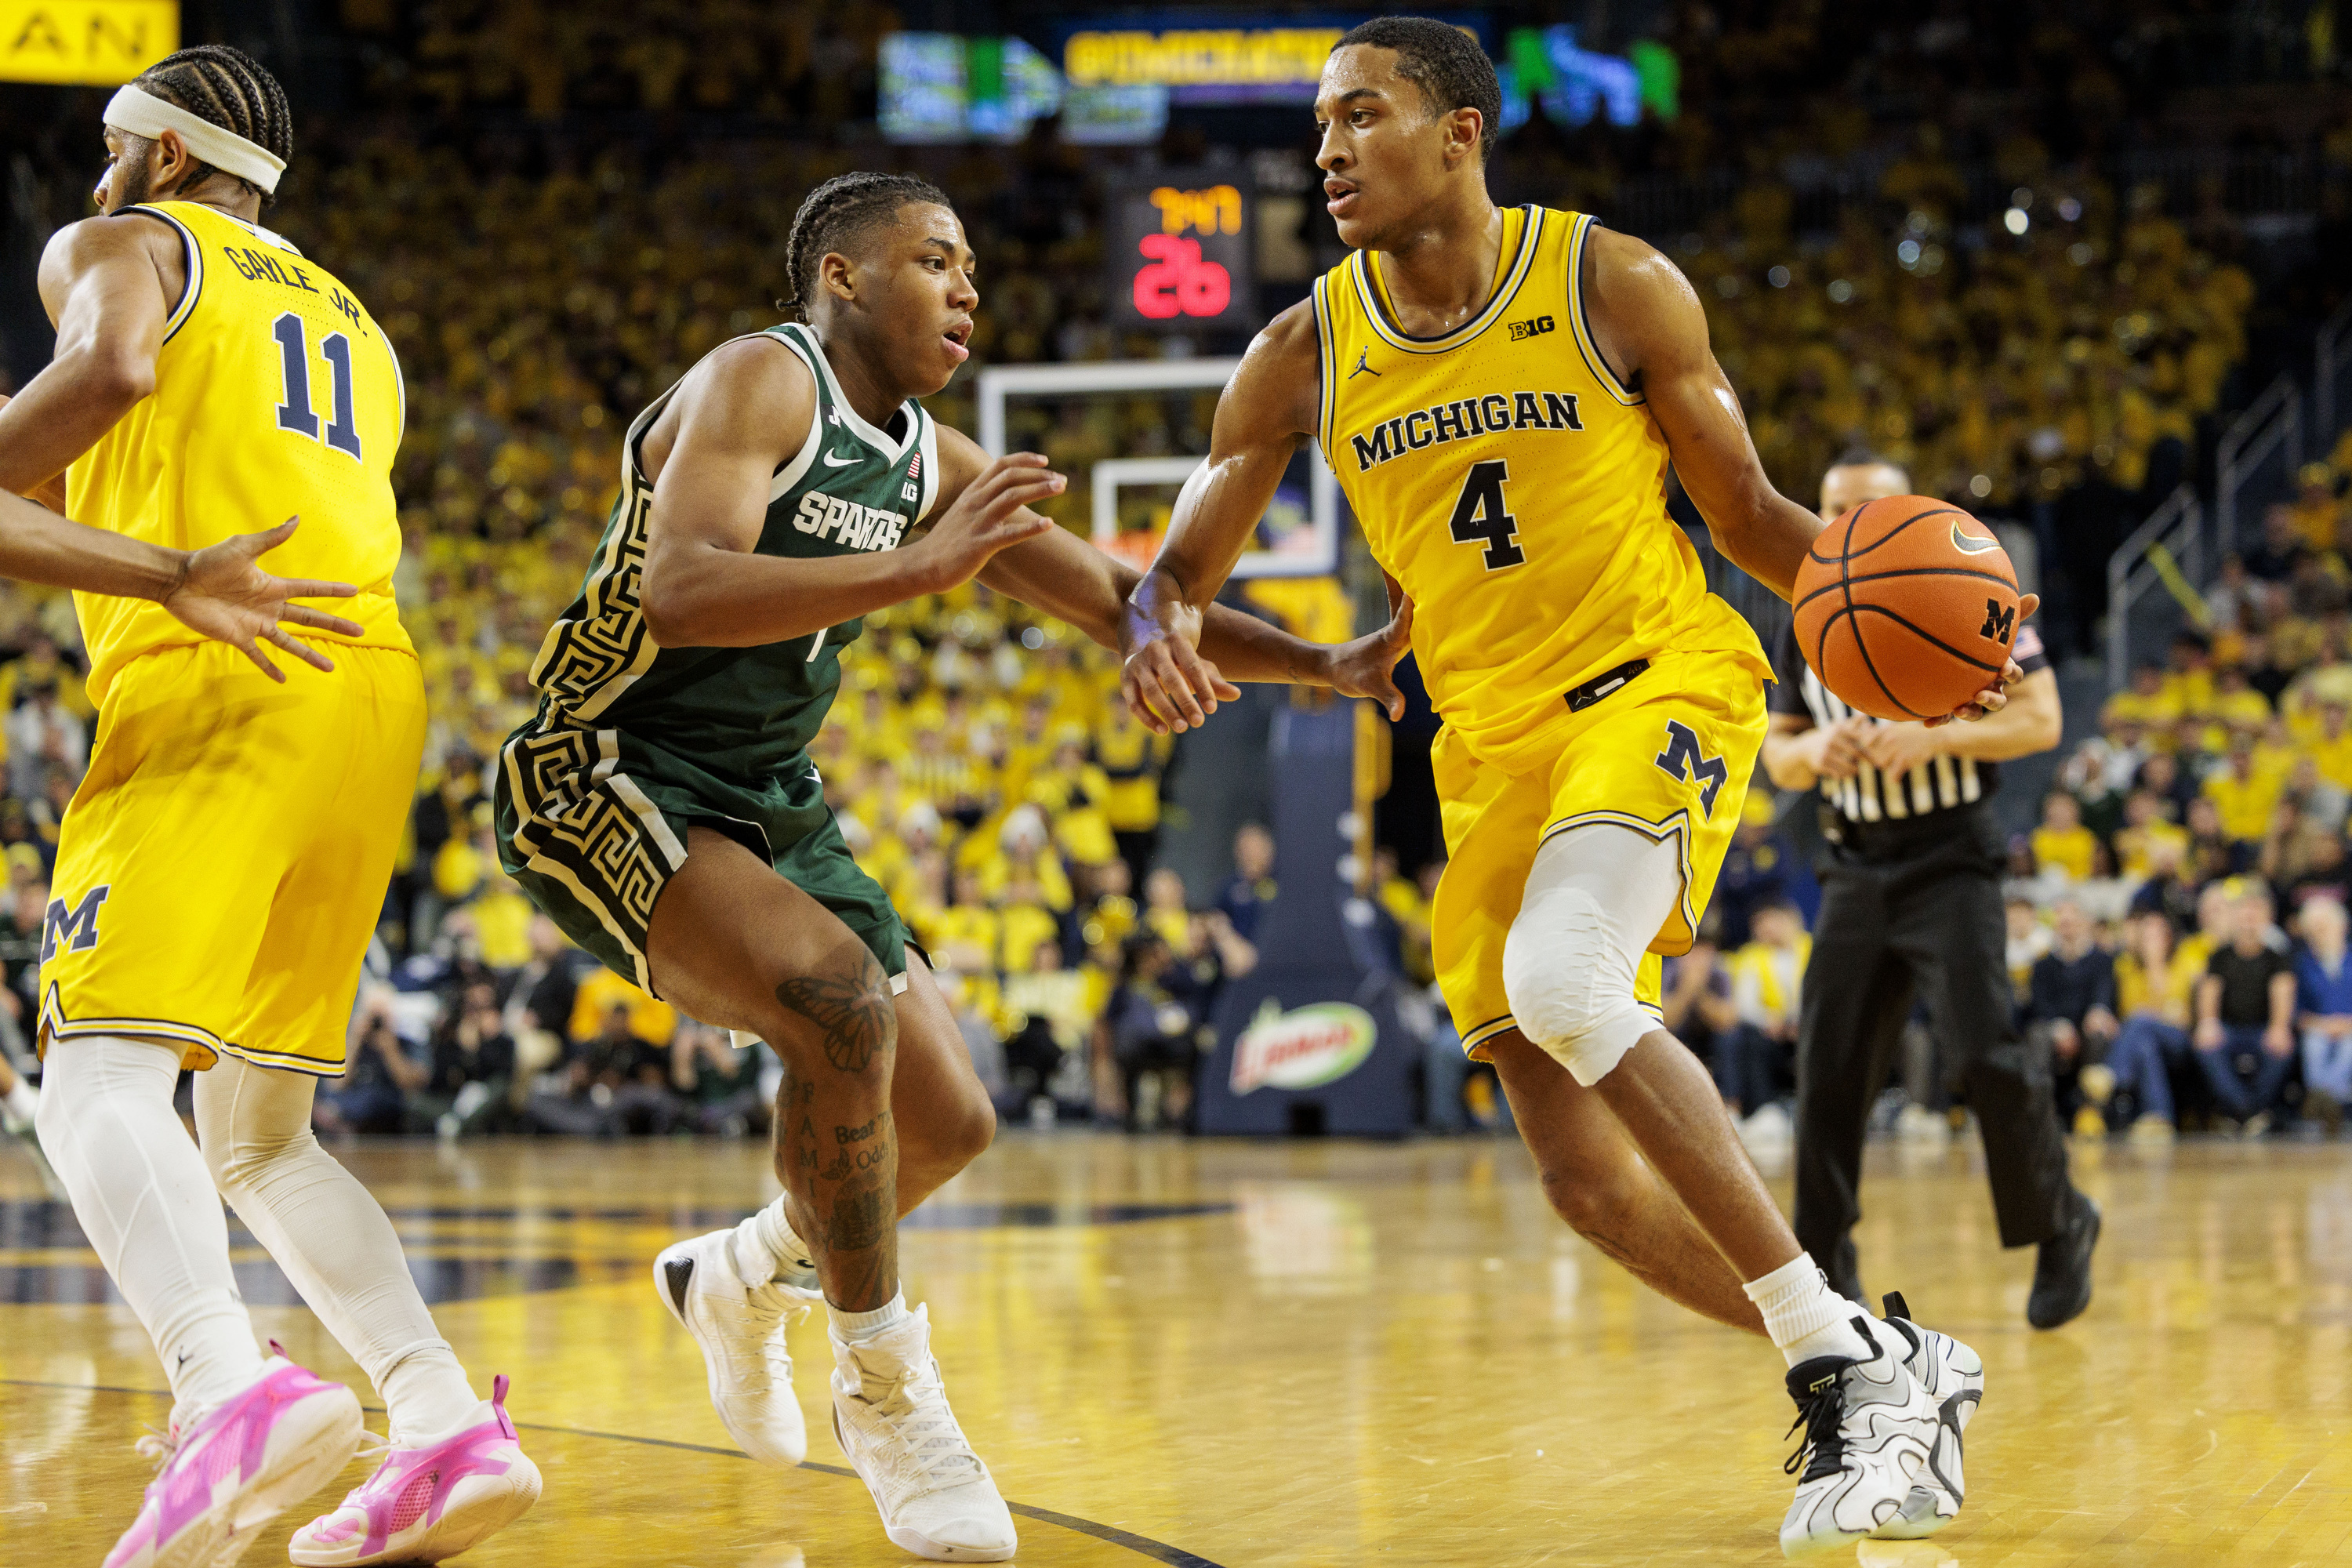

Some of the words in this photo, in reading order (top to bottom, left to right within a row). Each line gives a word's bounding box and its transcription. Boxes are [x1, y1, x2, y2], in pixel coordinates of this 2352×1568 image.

[223, 246, 320, 294] GAYLE
[328, 287, 368, 337] JR.
[1134, 234, 1230, 319] 26
[271, 310, 362, 464] 11
[1350, 391, 1584, 473] MICHIGAN
[1448, 458, 1527, 572] 4
[1978, 597, 2015, 645] M
[1654, 718, 1727, 822] M
[40, 884, 111, 969] M
